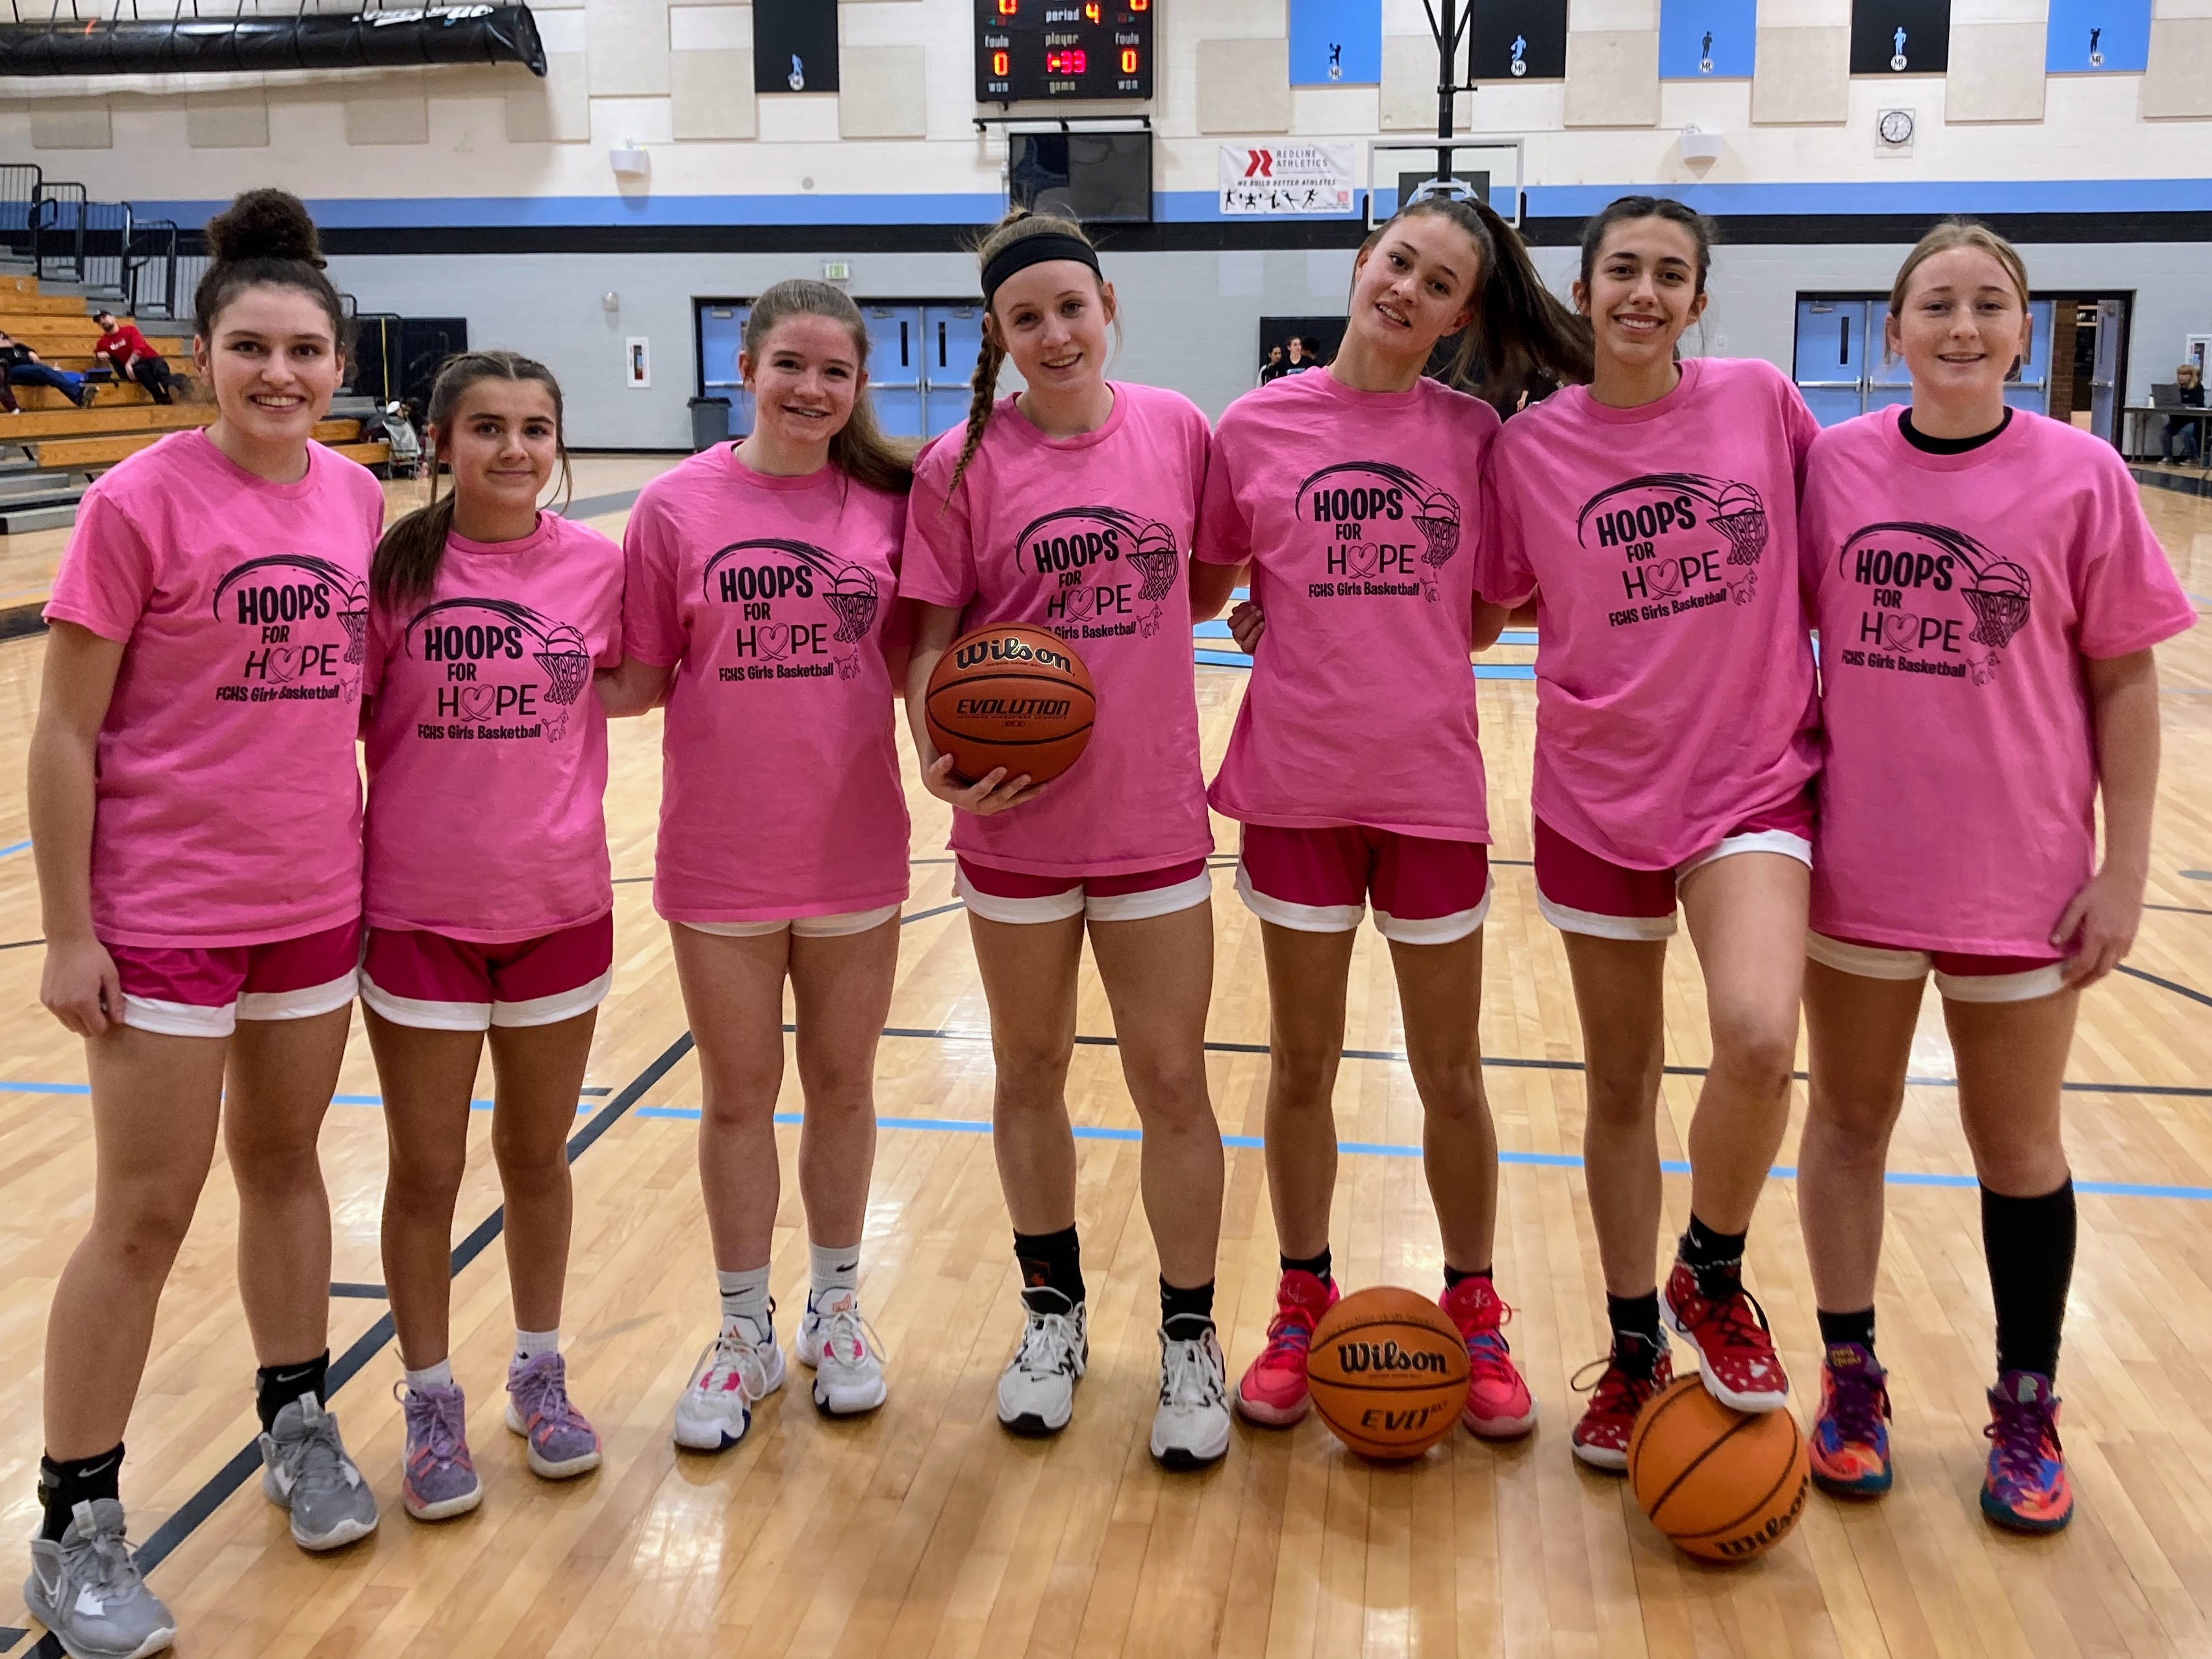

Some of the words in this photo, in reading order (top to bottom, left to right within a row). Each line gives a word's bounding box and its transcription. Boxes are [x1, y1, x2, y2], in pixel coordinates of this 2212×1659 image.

[1046, 7, 1079, 23] period
[1085, 3, 1100, 25] 4
[985, 34, 1009, 47] fouls
[1046, 31, 1079, 47] player
[1115, 31, 1139, 45] fouls
[993, 51, 1009, 76] 0
[1122, 48, 1137, 73] 0
[988, 81, 1009, 92] won
[1118, 79, 1138, 90] won
[1276, 159, 1327, 168] ATHLETICS
[1313, 488, 1403, 522] HOOPS
[1335, 523, 1362, 540] FOR
[1596, 496, 1696, 548] HOOPS
[1033, 529, 1119, 574] HOOPS
[1626, 541, 1656, 563] FOR
[1058, 570, 1082, 589] FOR
[1855, 549, 1955, 591] HOOPS
[720, 565, 814, 603] HOOPS
[1309, 583, 1335, 598] FCHS
[1337, 582, 1362, 596] Girls
[1364, 581, 1420, 596] Basketball
[237, 583, 330, 625] HOOPS
[1608, 608, 1639, 627] FCHS
[1641, 603, 1670, 621] Girls
[1672, 588, 1727, 614] Basketball
[1873, 588, 1902, 609] FOR
[743, 602, 772, 622] FOR
[261, 625, 290, 644] FOR
[1055, 626, 1079, 639] Girls
[1082, 622, 1137, 639] Basketball
[424, 625, 523, 661] HOOPS
[955, 637, 1072, 674] Wilson
[1868, 653, 1895, 670] Girls
[1898, 656, 1967, 678] Basketball
[447, 662, 477, 681] FOR
[719, 667, 745, 681] FCHS
[748, 665, 773, 679] Girls
[777, 663, 834, 678] Basketball
[216, 686, 248, 702] FCHS
[956, 699, 1071, 715] EVOLUTION
[418, 724, 444, 739] FCHS
[447, 725, 474, 739] Girls
[477, 724, 541, 739] Basketball
[1337, 1340, 1448, 1374] Wilson
